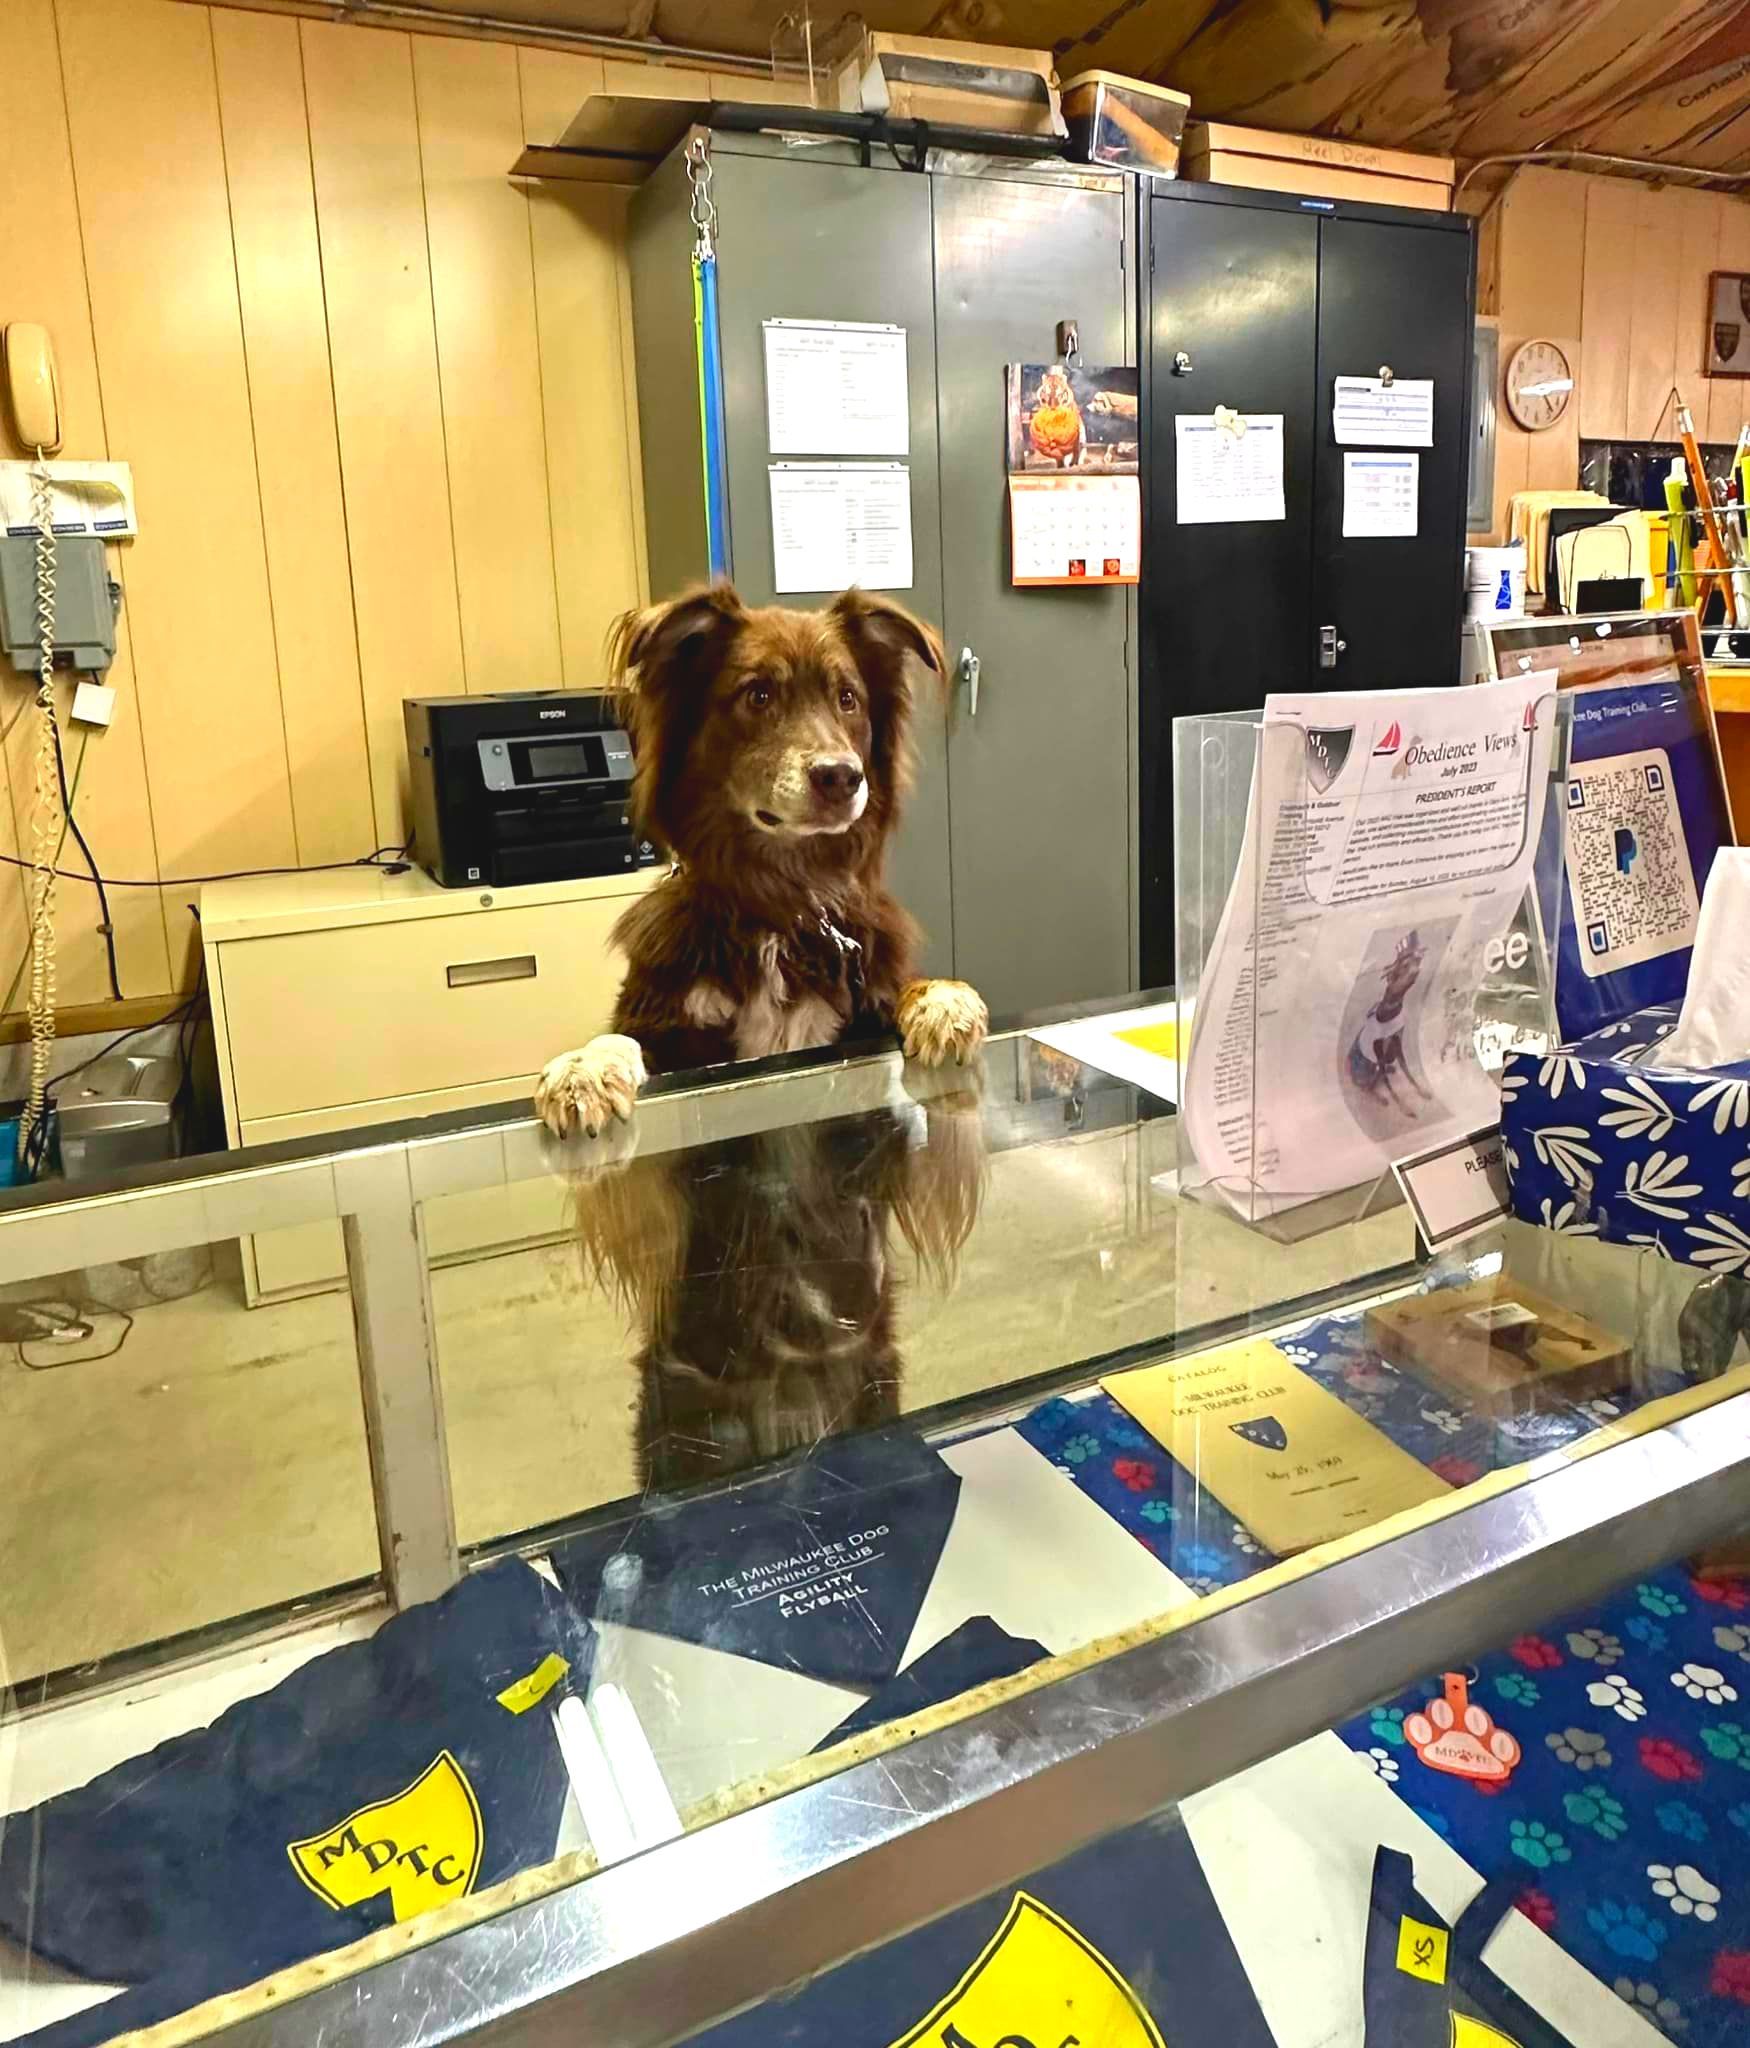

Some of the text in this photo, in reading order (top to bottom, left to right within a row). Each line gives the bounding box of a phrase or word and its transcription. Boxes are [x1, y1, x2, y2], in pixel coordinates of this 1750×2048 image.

[539, 710, 566, 719] EPSON
[1586, 709, 1602, 721] Dog
[1602, 705, 1631, 716] Training
[1404, 733, 1517, 766] Obedience Views
[1440, 762, 1478, 778] July 2023
[1415, 781, 1497, 804] PRESIDENT'S REPORT
[1464, 1150, 1503, 1175] PLEASE
[1168, 1365, 1227, 1383] CATALOG
[1256, 1386, 1287, 1399] CLUB
[697, 1524, 890, 1597] THE MILWAUKEE DOG
[732, 1546, 873, 1600] TRAINING CLUB
[778, 1571, 854, 1607] AGILITY
[780, 1584, 868, 1619] FLYBALL
[315, 1825, 465, 1886] MDTC
[1413, 1936, 1435, 1967] XS
